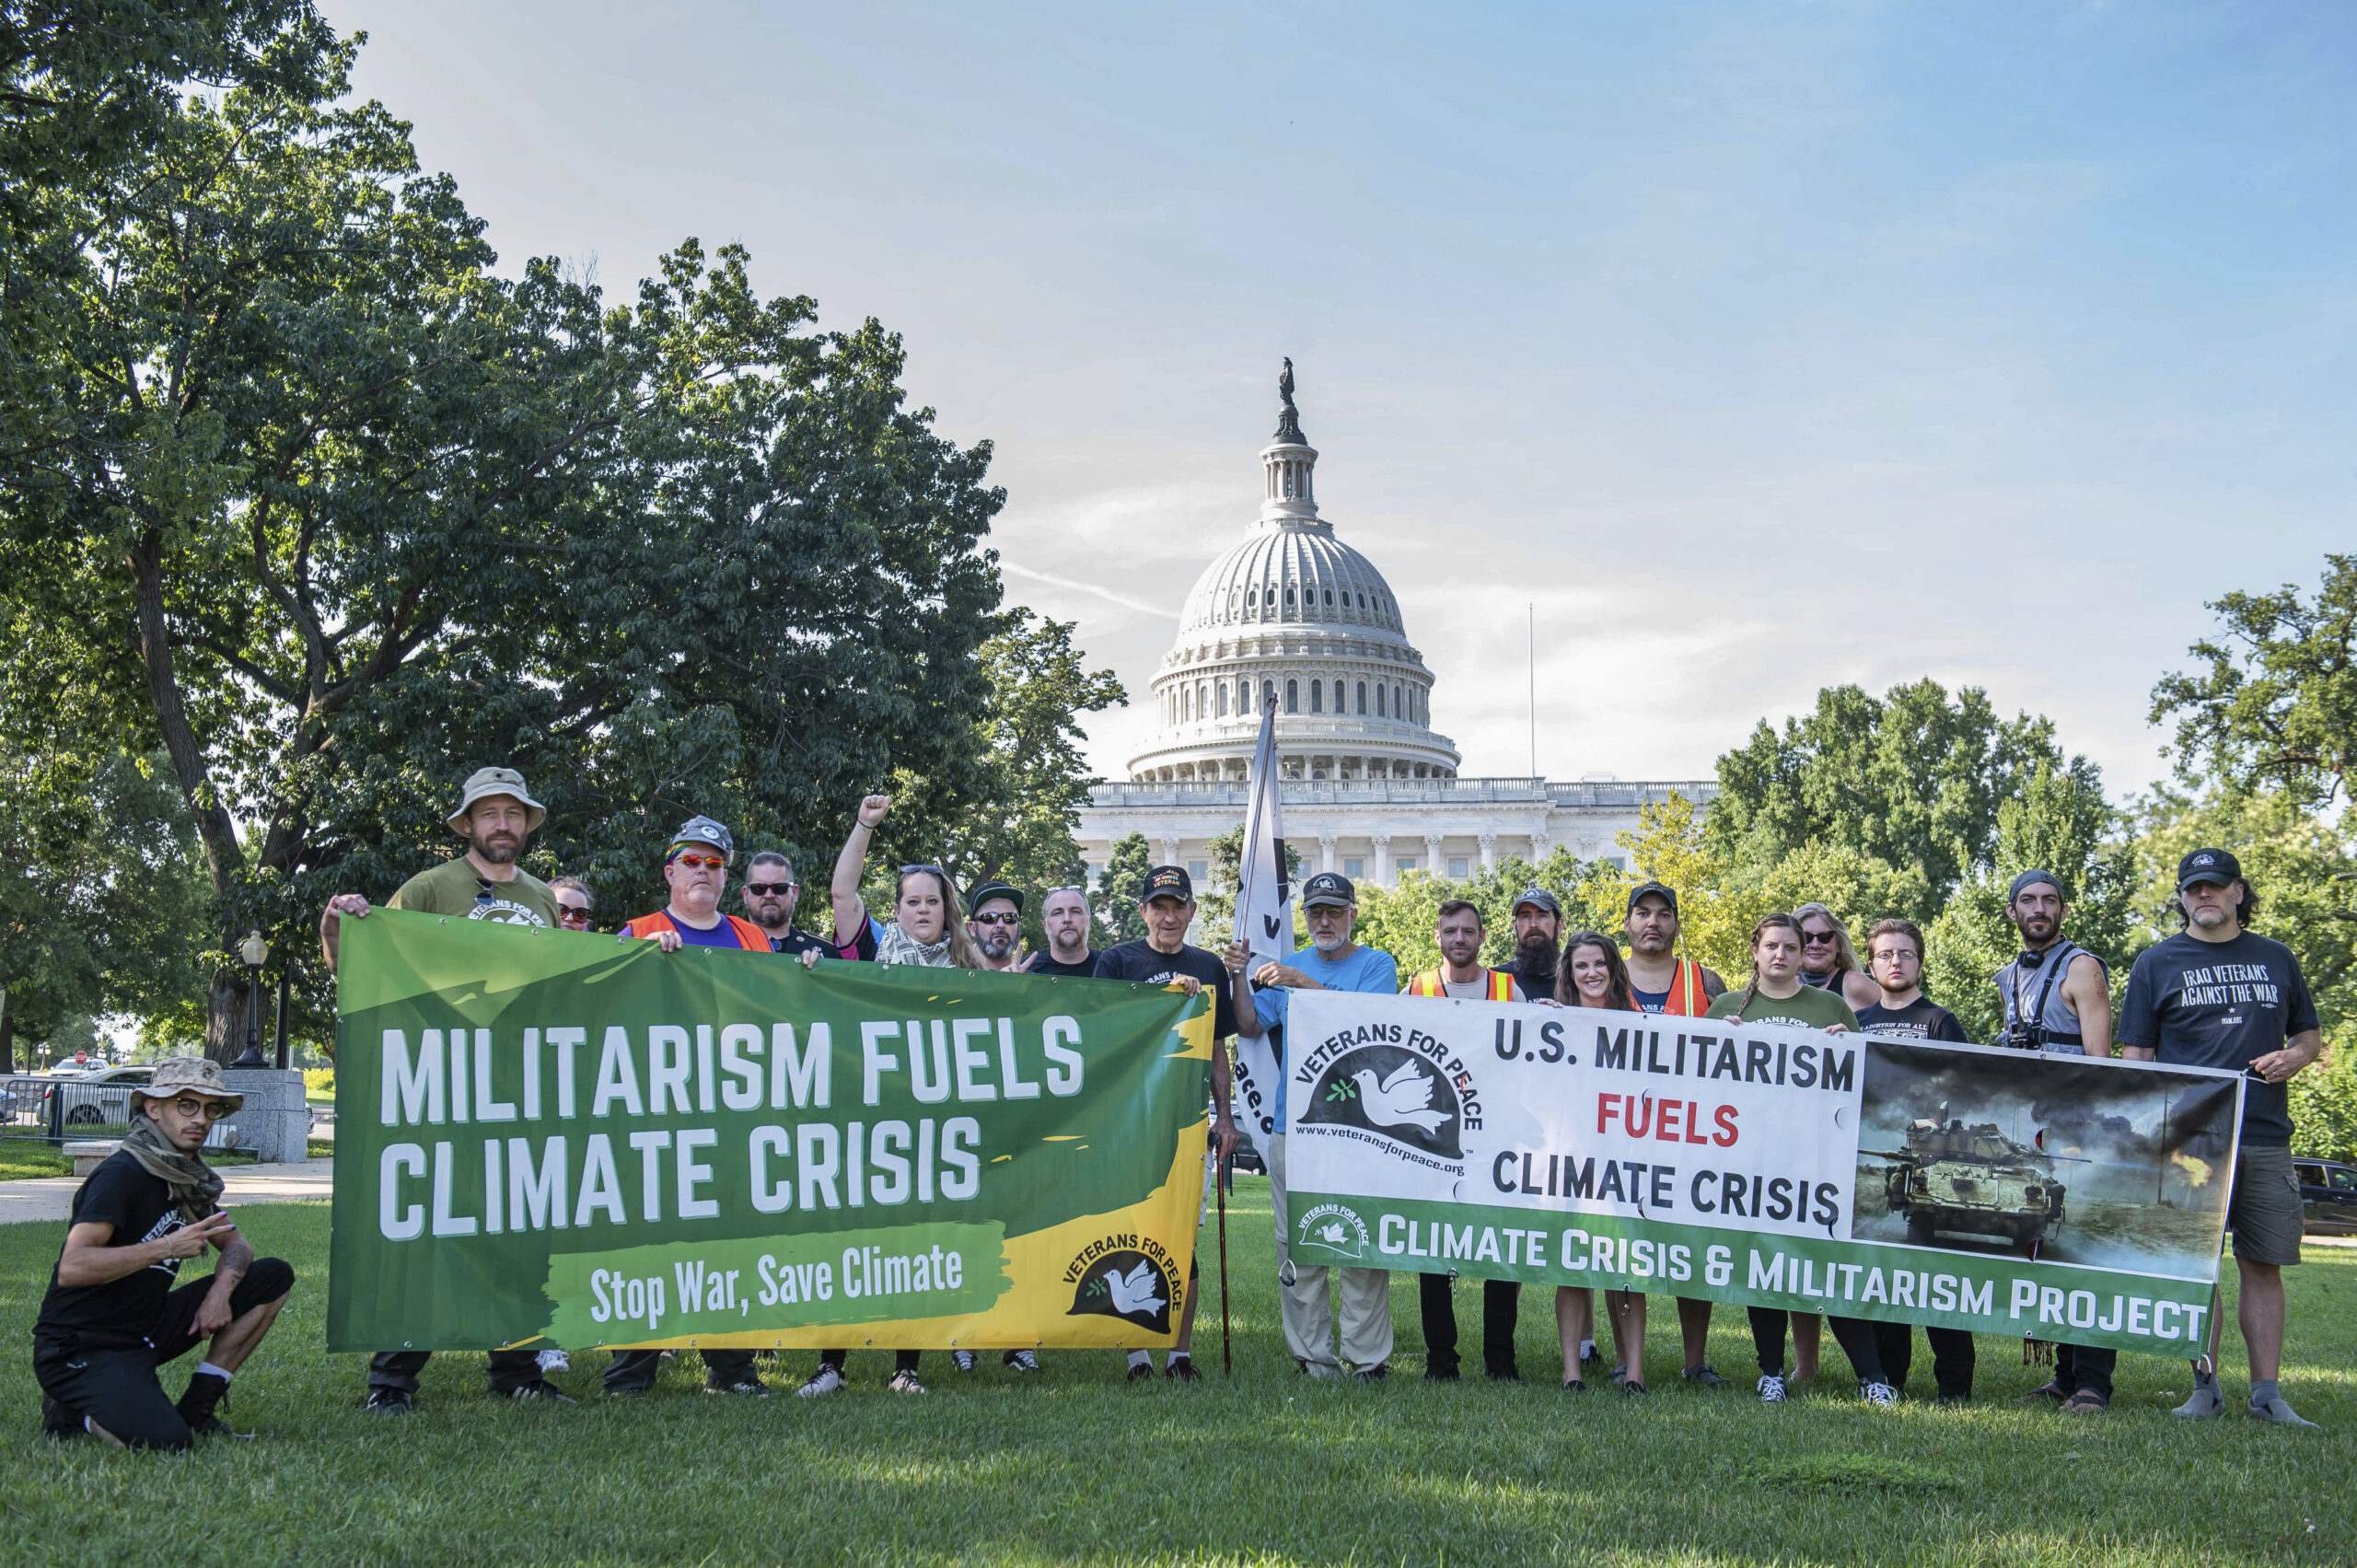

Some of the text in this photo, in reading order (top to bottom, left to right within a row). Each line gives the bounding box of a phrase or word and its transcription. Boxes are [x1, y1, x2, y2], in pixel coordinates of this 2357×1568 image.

[513, 902, 532, 915] FOR
[2181, 983, 2279, 1007] AGAINST THE WAR
[2183, 964, 2270, 987] IRAQ VETERANS
[1494, 1018, 1856, 1093] U.S. MILITARISM
[1789, 1017, 1809, 1028] FOR
[380, 1015, 1085, 1126] MILITARISM FUELS
[1295, 1024, 1482, 1131] VETERANS FOR PEACE
[1295, 1126, 1465, 1176] www.veteransforpeace.org
[1596, 1092, 1739, 1148] FUELS
[378, 1117, 981, 1241] CLIMATE CRISIS
[1492, 1151, 1840, 1226] CLIMATE CRISIS
[1298, 1203, 1369, 1247] VETERANS FOR PEACE
[590, 1243, 963, 1330] Stop War, Save Climate
[1062, 1234, 1182, 1312] VETERANS FOR PEACE
[1378, 1214, 2208, 1342] CLIMATE CRISIS & MILITARISM PROJECT
